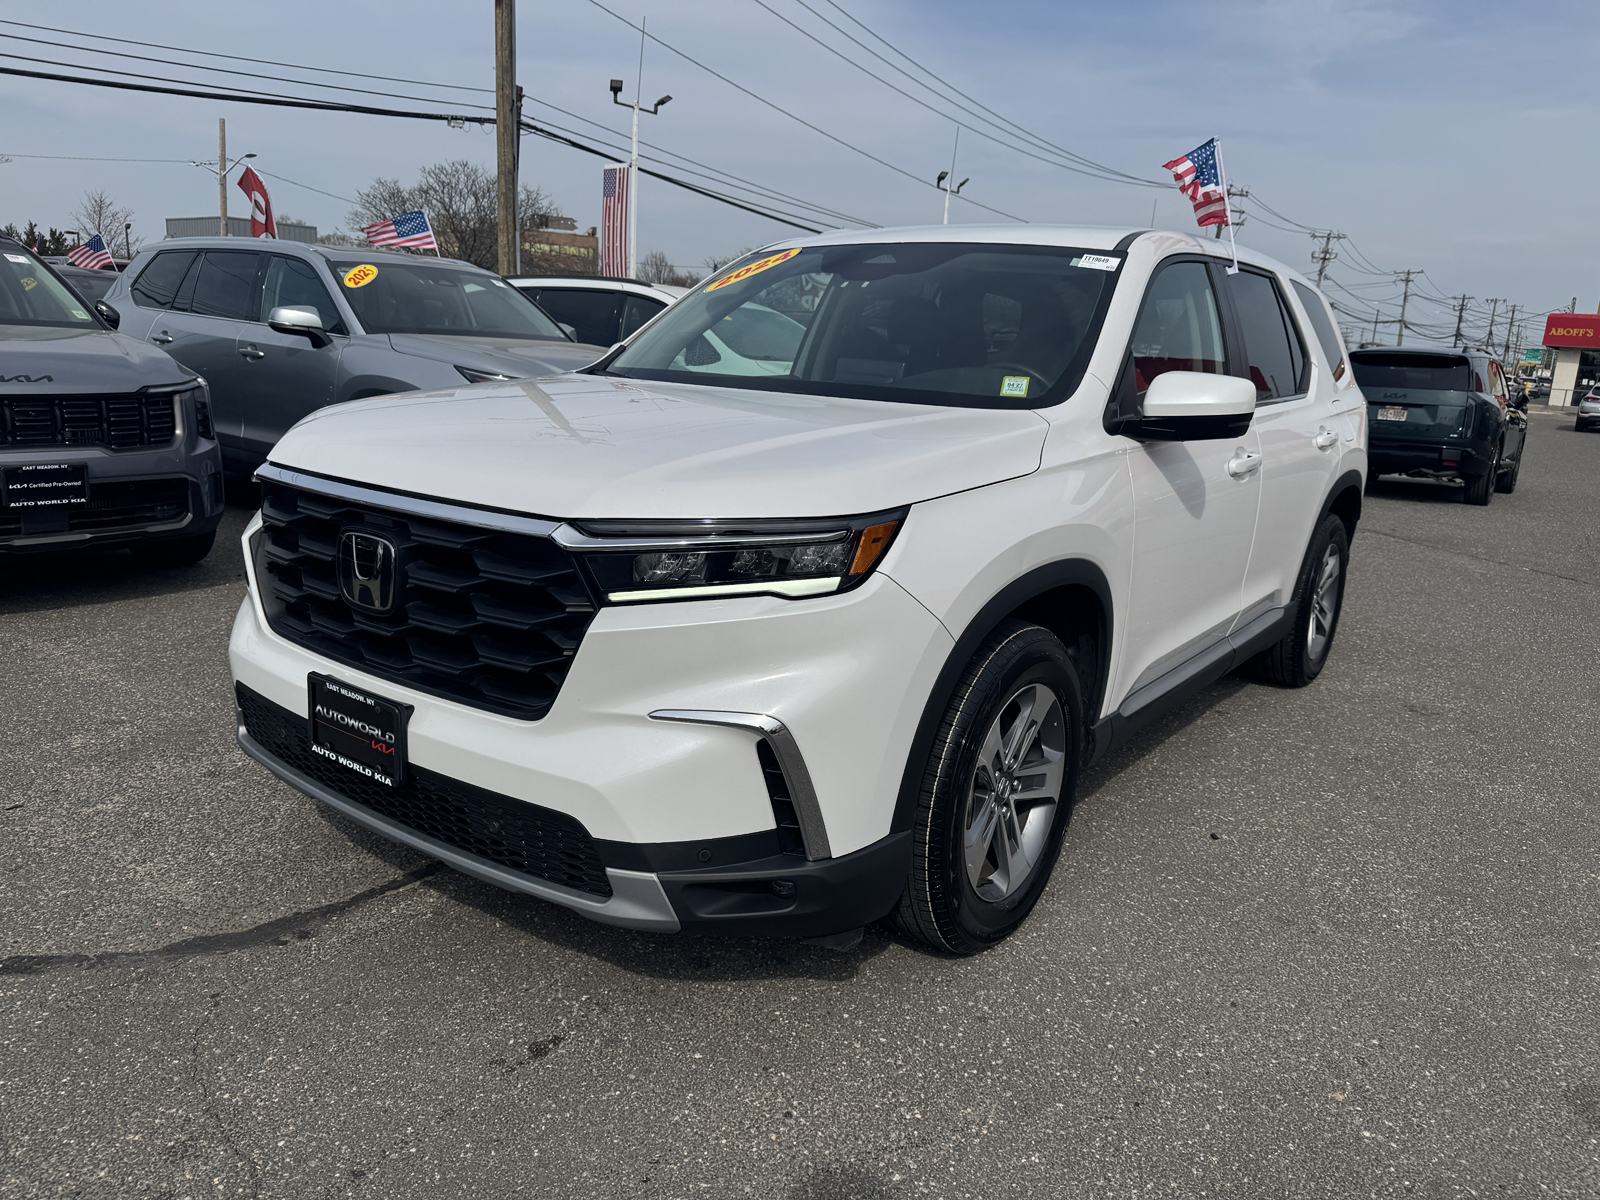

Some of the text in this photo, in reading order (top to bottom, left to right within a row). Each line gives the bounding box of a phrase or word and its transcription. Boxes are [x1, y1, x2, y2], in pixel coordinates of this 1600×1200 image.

[713, 251, 792, 290] 2024
[1548, 327, 1594, 337] ABOFF'S
[52, 480, 82, 488] Pre-Owned
[325, 682, 340, 693] EAST
[366, 698, 375, 706] NY
[315, 704, 395, 744] AUTOWORLD
[371, 740, 396, 756] KIA
[311, 744, 393, 787] AUTO WORLD KIA
